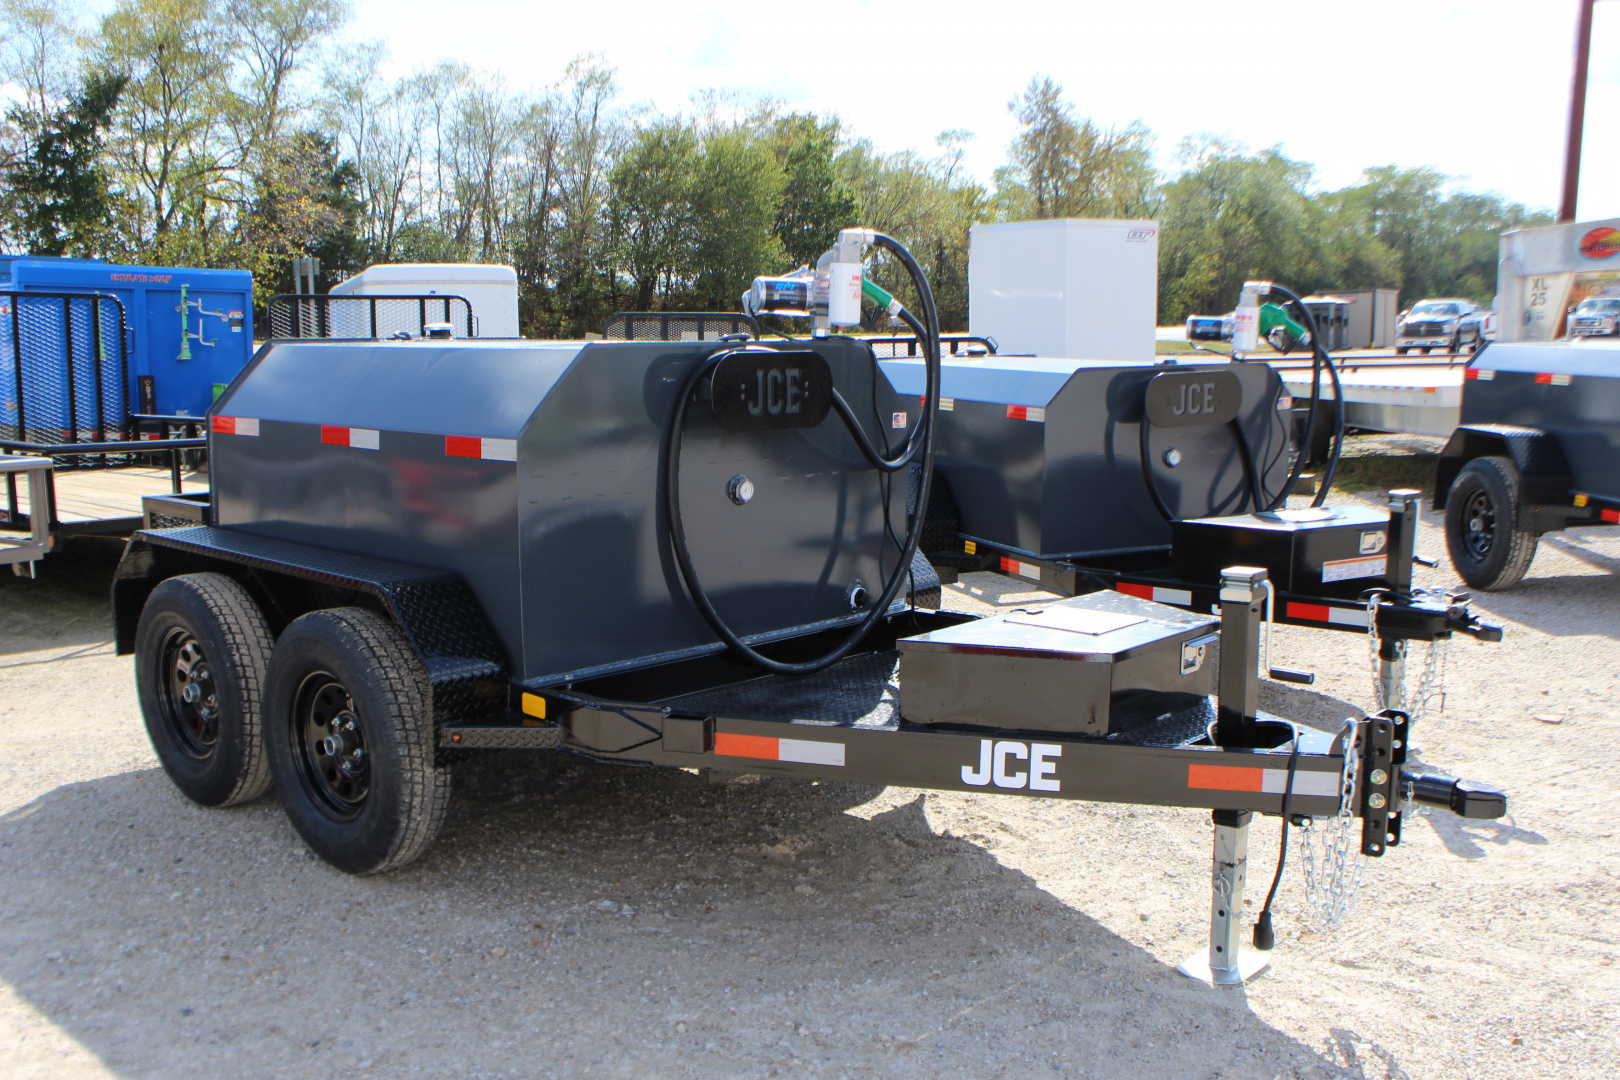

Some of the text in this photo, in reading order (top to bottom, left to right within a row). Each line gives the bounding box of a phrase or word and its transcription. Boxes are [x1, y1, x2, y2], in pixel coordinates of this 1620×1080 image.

[1530, 292, 1547, 307] 25
[1531, 278, 1548, 291] XL
[747, 368, 801, 417] JCE
[1172, 382, 1216, 416] JCE
[961, 739, 1062, 792] JCE
